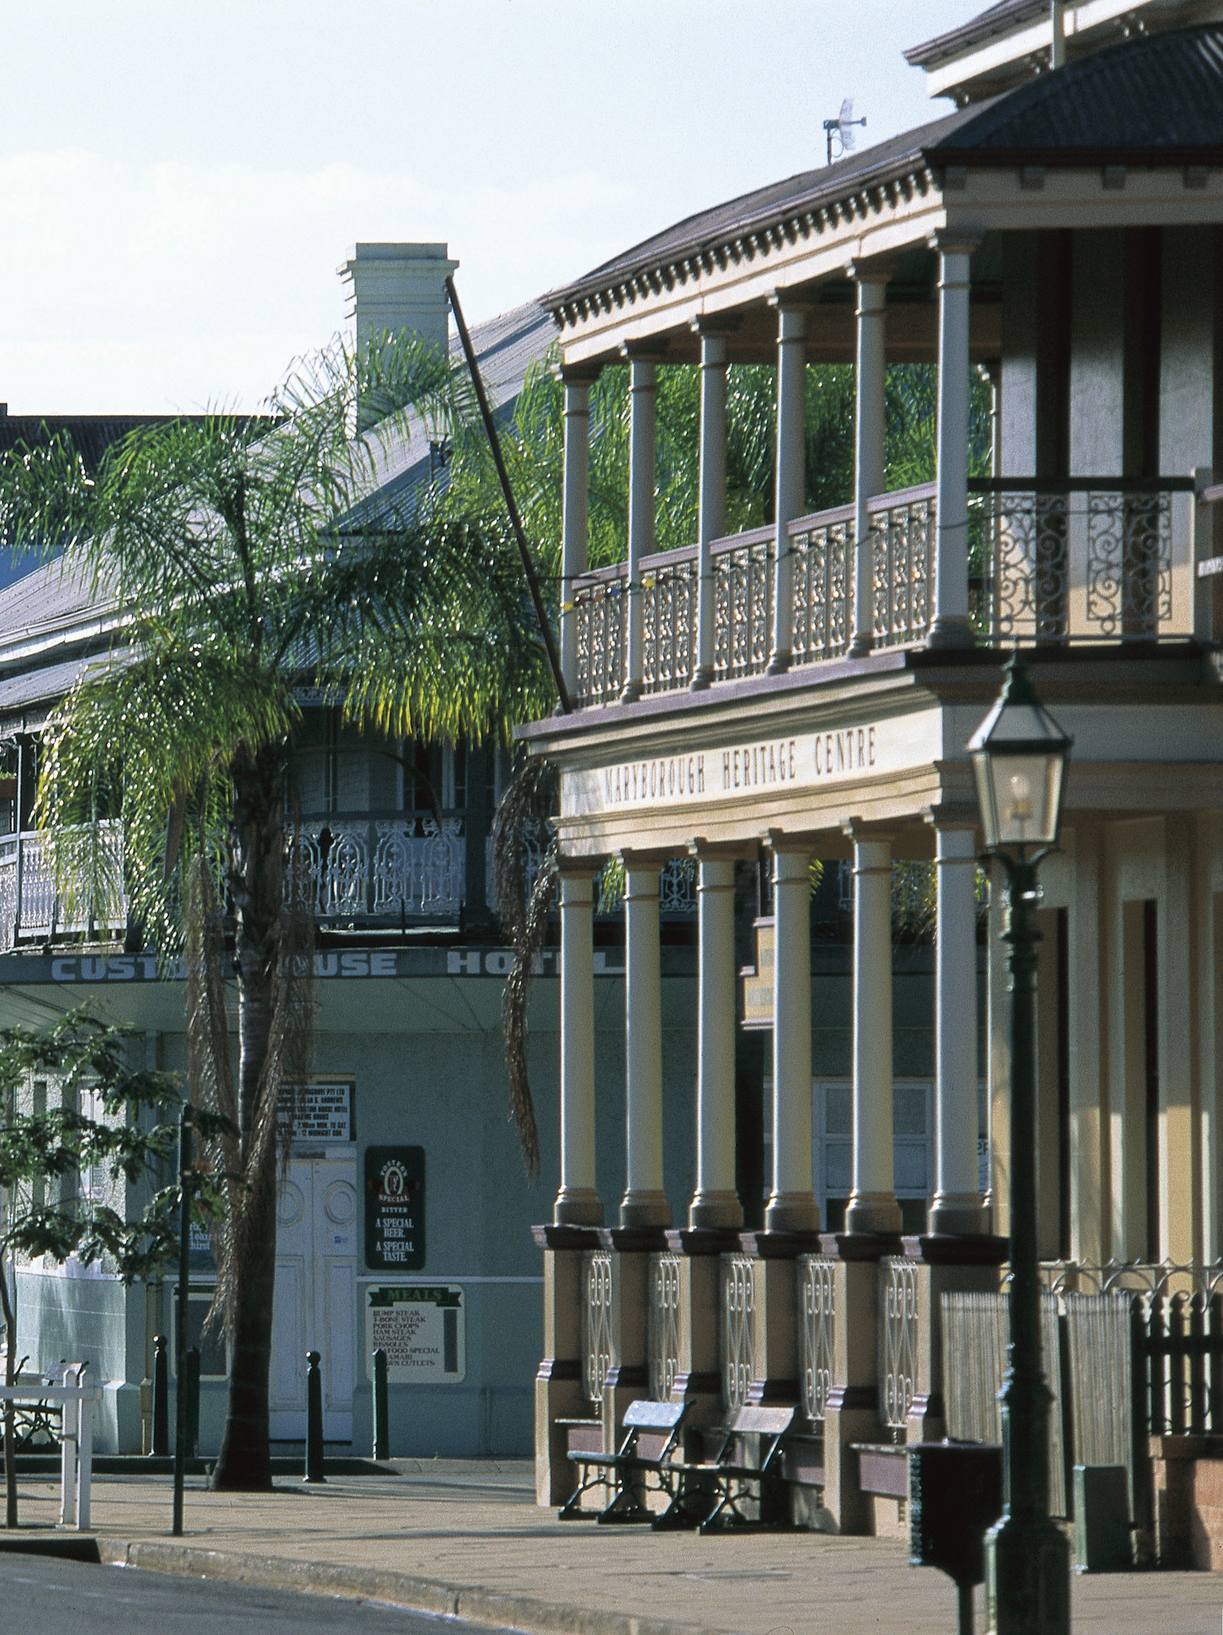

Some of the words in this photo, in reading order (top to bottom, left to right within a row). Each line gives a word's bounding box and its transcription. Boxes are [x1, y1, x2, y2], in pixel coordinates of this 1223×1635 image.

[605, 755, 705, 804] MARYBOROUGH
[723, 740, 796, 789] HERITAGE
[814, 726, 877, 775] CENTRE
[51, 956, 224, 981] CUSTO
[447, 951, 626, 975] HOTL
[378, 1194, 410, 1203] SPECIAL
[375, 1218, 382, 1228] A
[383, 1218, 414, 1228] SPECIAL
[383, 1228, 406, 1238] BEER.
[375, 1241, 382, 1251] A
[383, 1241, 414, 1252] SPECIAL
[383, 1252, 408, 1262] TASTE.
[387, 1289, 443, 1301] MEALS
